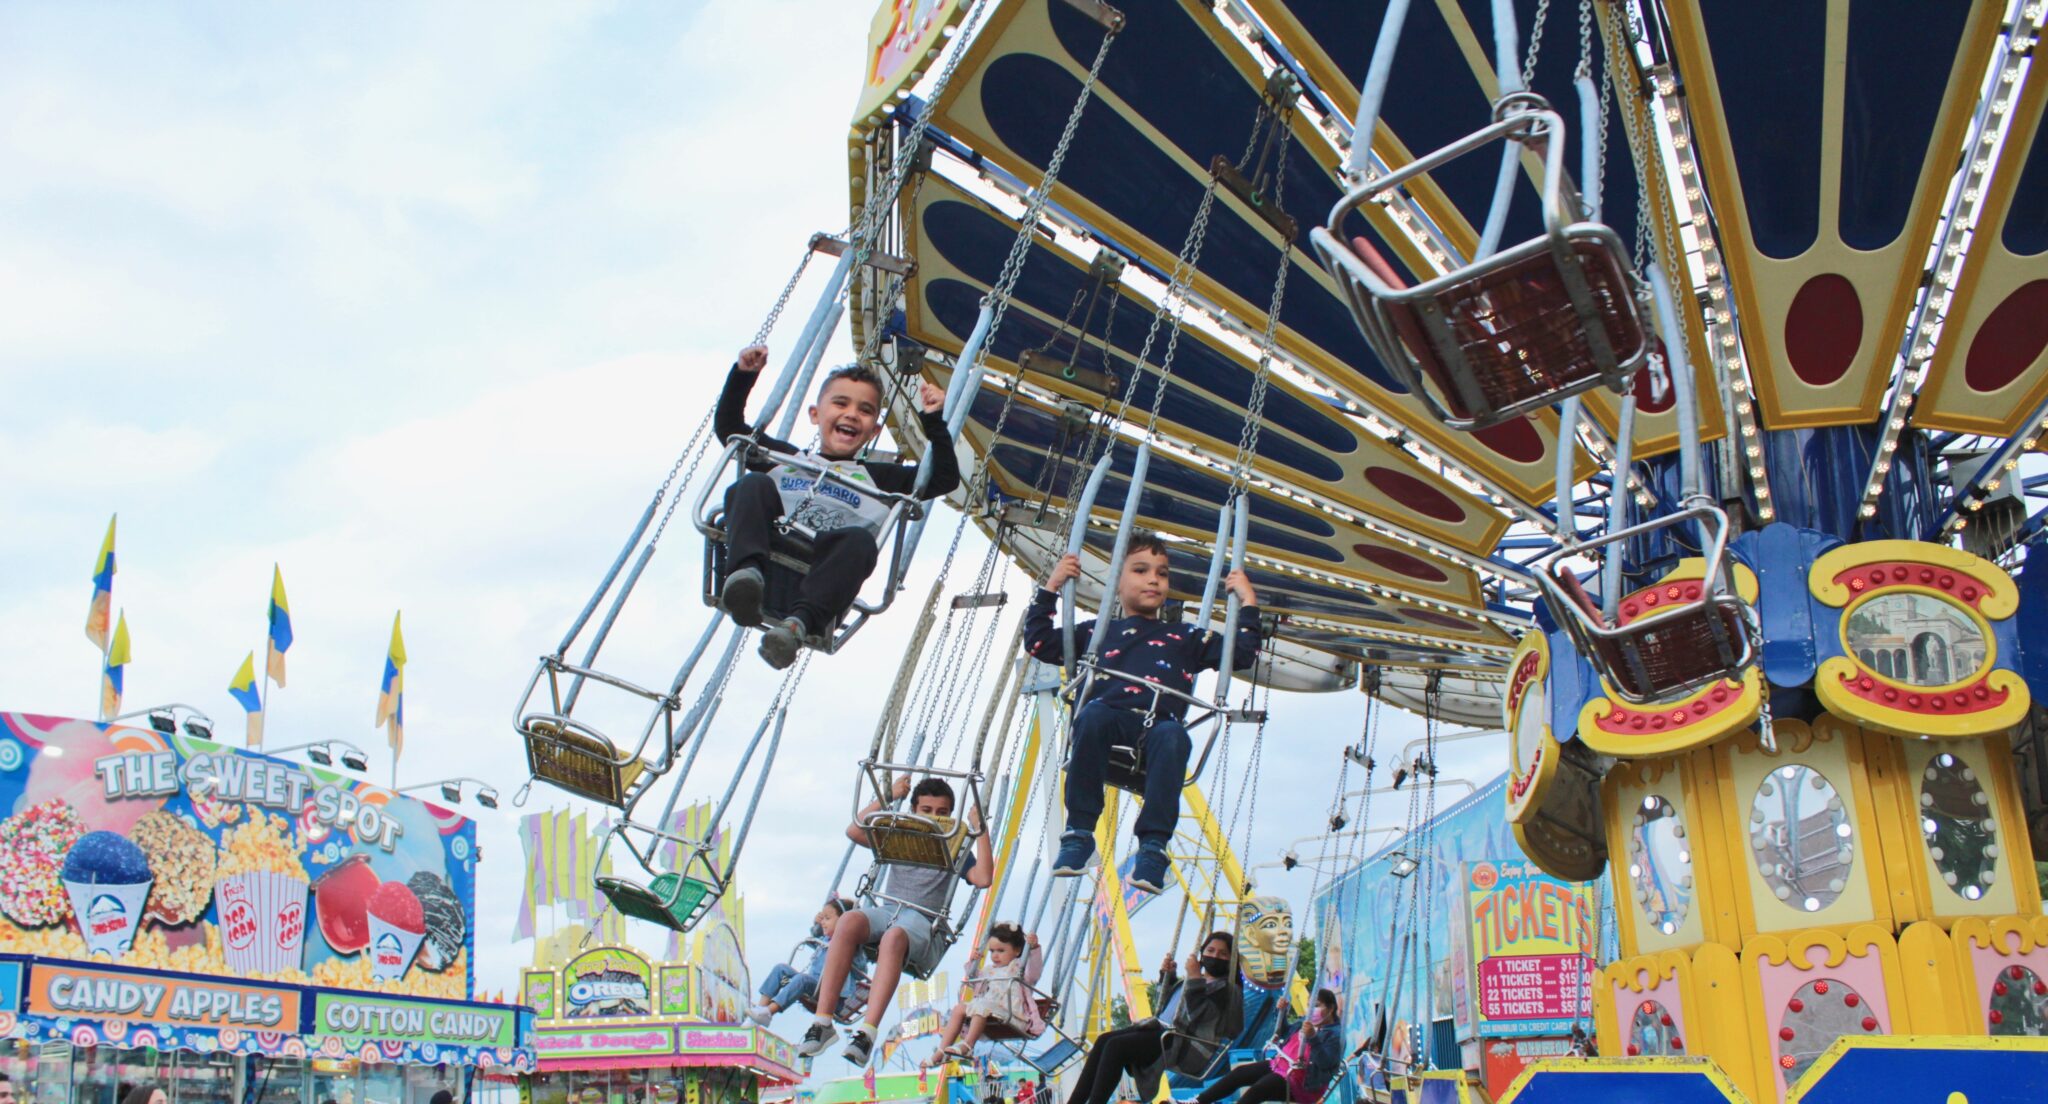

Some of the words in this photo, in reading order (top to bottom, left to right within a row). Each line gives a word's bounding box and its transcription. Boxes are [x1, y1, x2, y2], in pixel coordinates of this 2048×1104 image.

[781, 476, 818, 491] SUPE
[820, 483, 862, 509] MARIO
[95, 749, 179, 798] THE
[185, 752, 311, 813] SWEET
[314, 785, 402, 850] SPOT
[224, 905, 245, 928] POP
[1474, 881, 1593, 957] TICKETS
[228, 917, 257, 944] CORN
[1497, 960, 1503, 973] 1
[1505, 958, 1541, 973] TICKET
[1487, 975, 1498, 987] 11
[1500, 972, 1542, 987] TICKETS
[49, 974, 166, 1017] CANDY
[168, 987, 282, 1026] APPLES
[1487, 988, 1500, 1001] 22
[1501, 987, 1544, 1001] TICKETS
[1488, 1002, 1500, 1016] 55
[1502, 1001, 1545, 1015] TICKETS
[324, 1001, 425, 1036] COTTON
[430, 1010, 504, 1042] CANDY
[1519, 1022, 1528, 1033] ON
[1529, 1021, 1550, 1032] CREDIT
[1552, 1021, 1568, 1031] CARD
[590, 1031, 667, 1051] Dough
